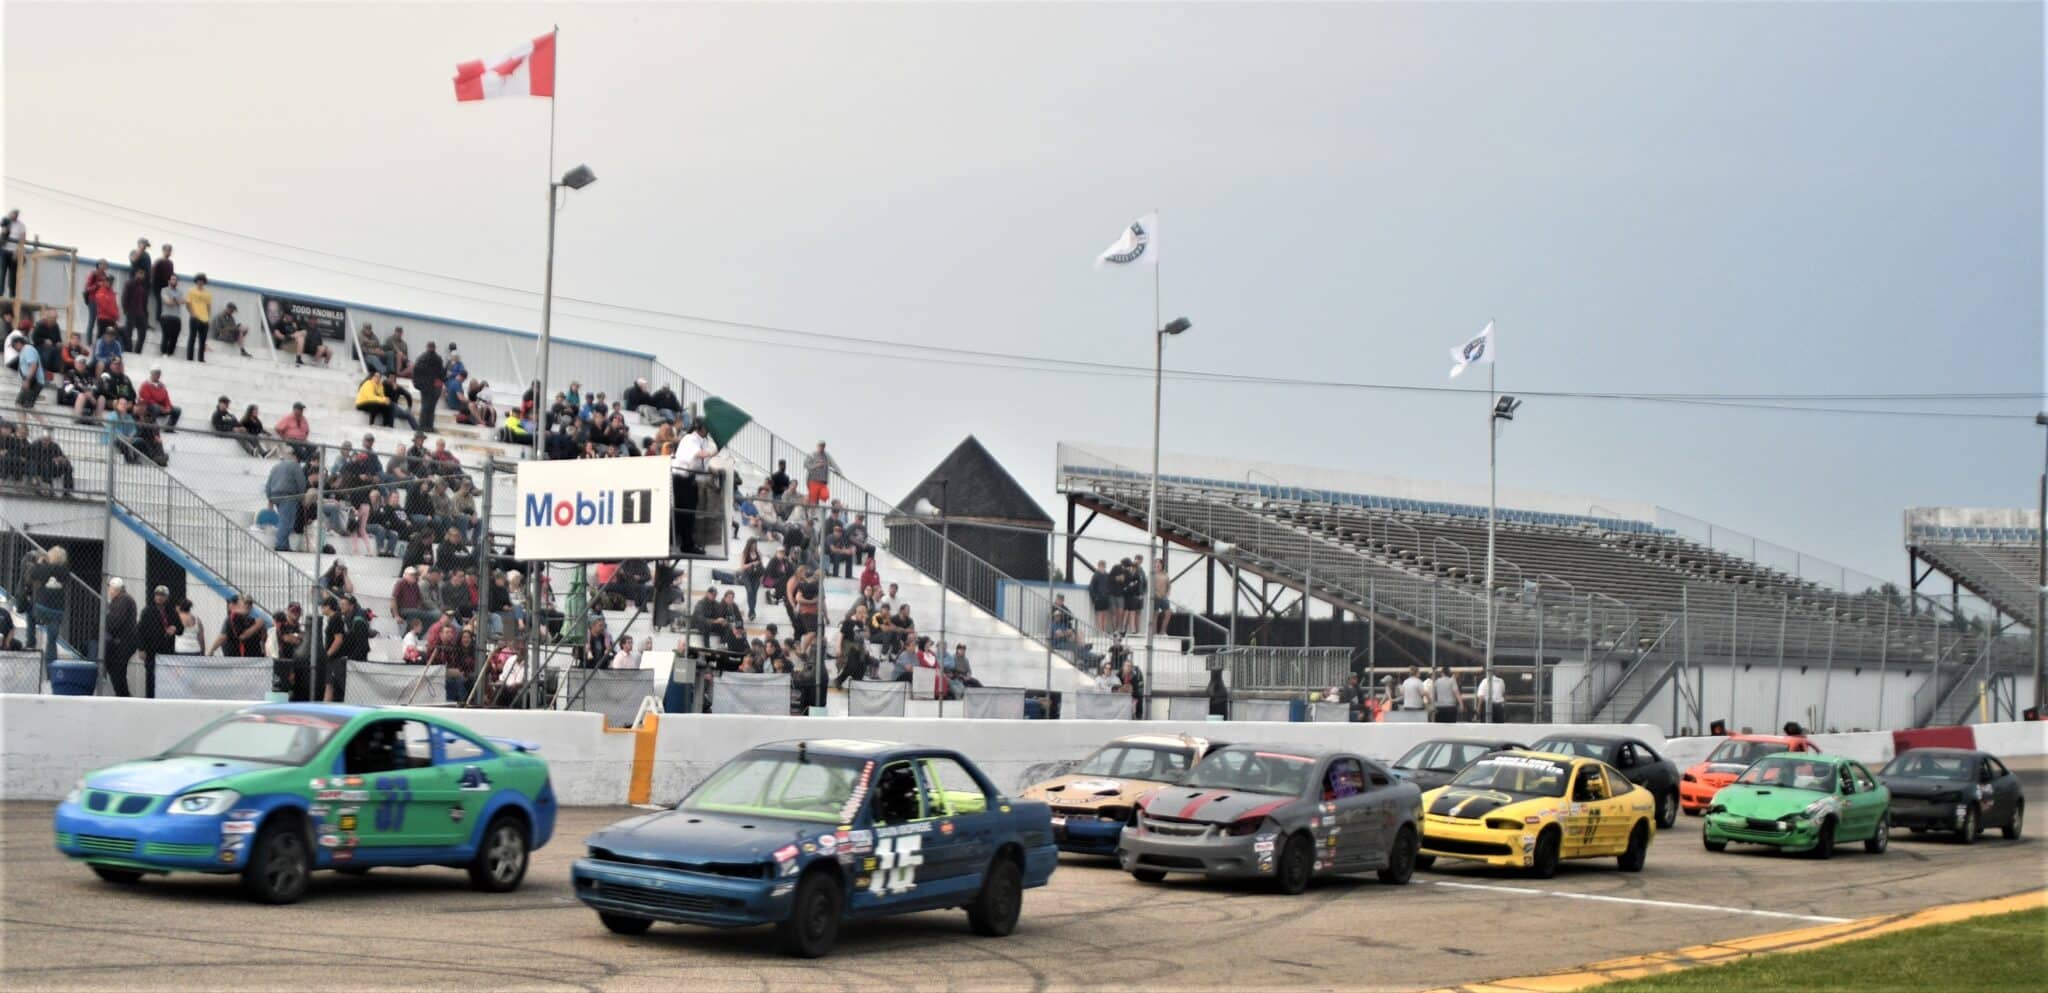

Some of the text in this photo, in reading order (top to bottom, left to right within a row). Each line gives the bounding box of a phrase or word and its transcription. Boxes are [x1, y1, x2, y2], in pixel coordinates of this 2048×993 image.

[291, 304, 344, 320] TODD KNOWLES
[525, 490, 641, 527] Mobil 1
